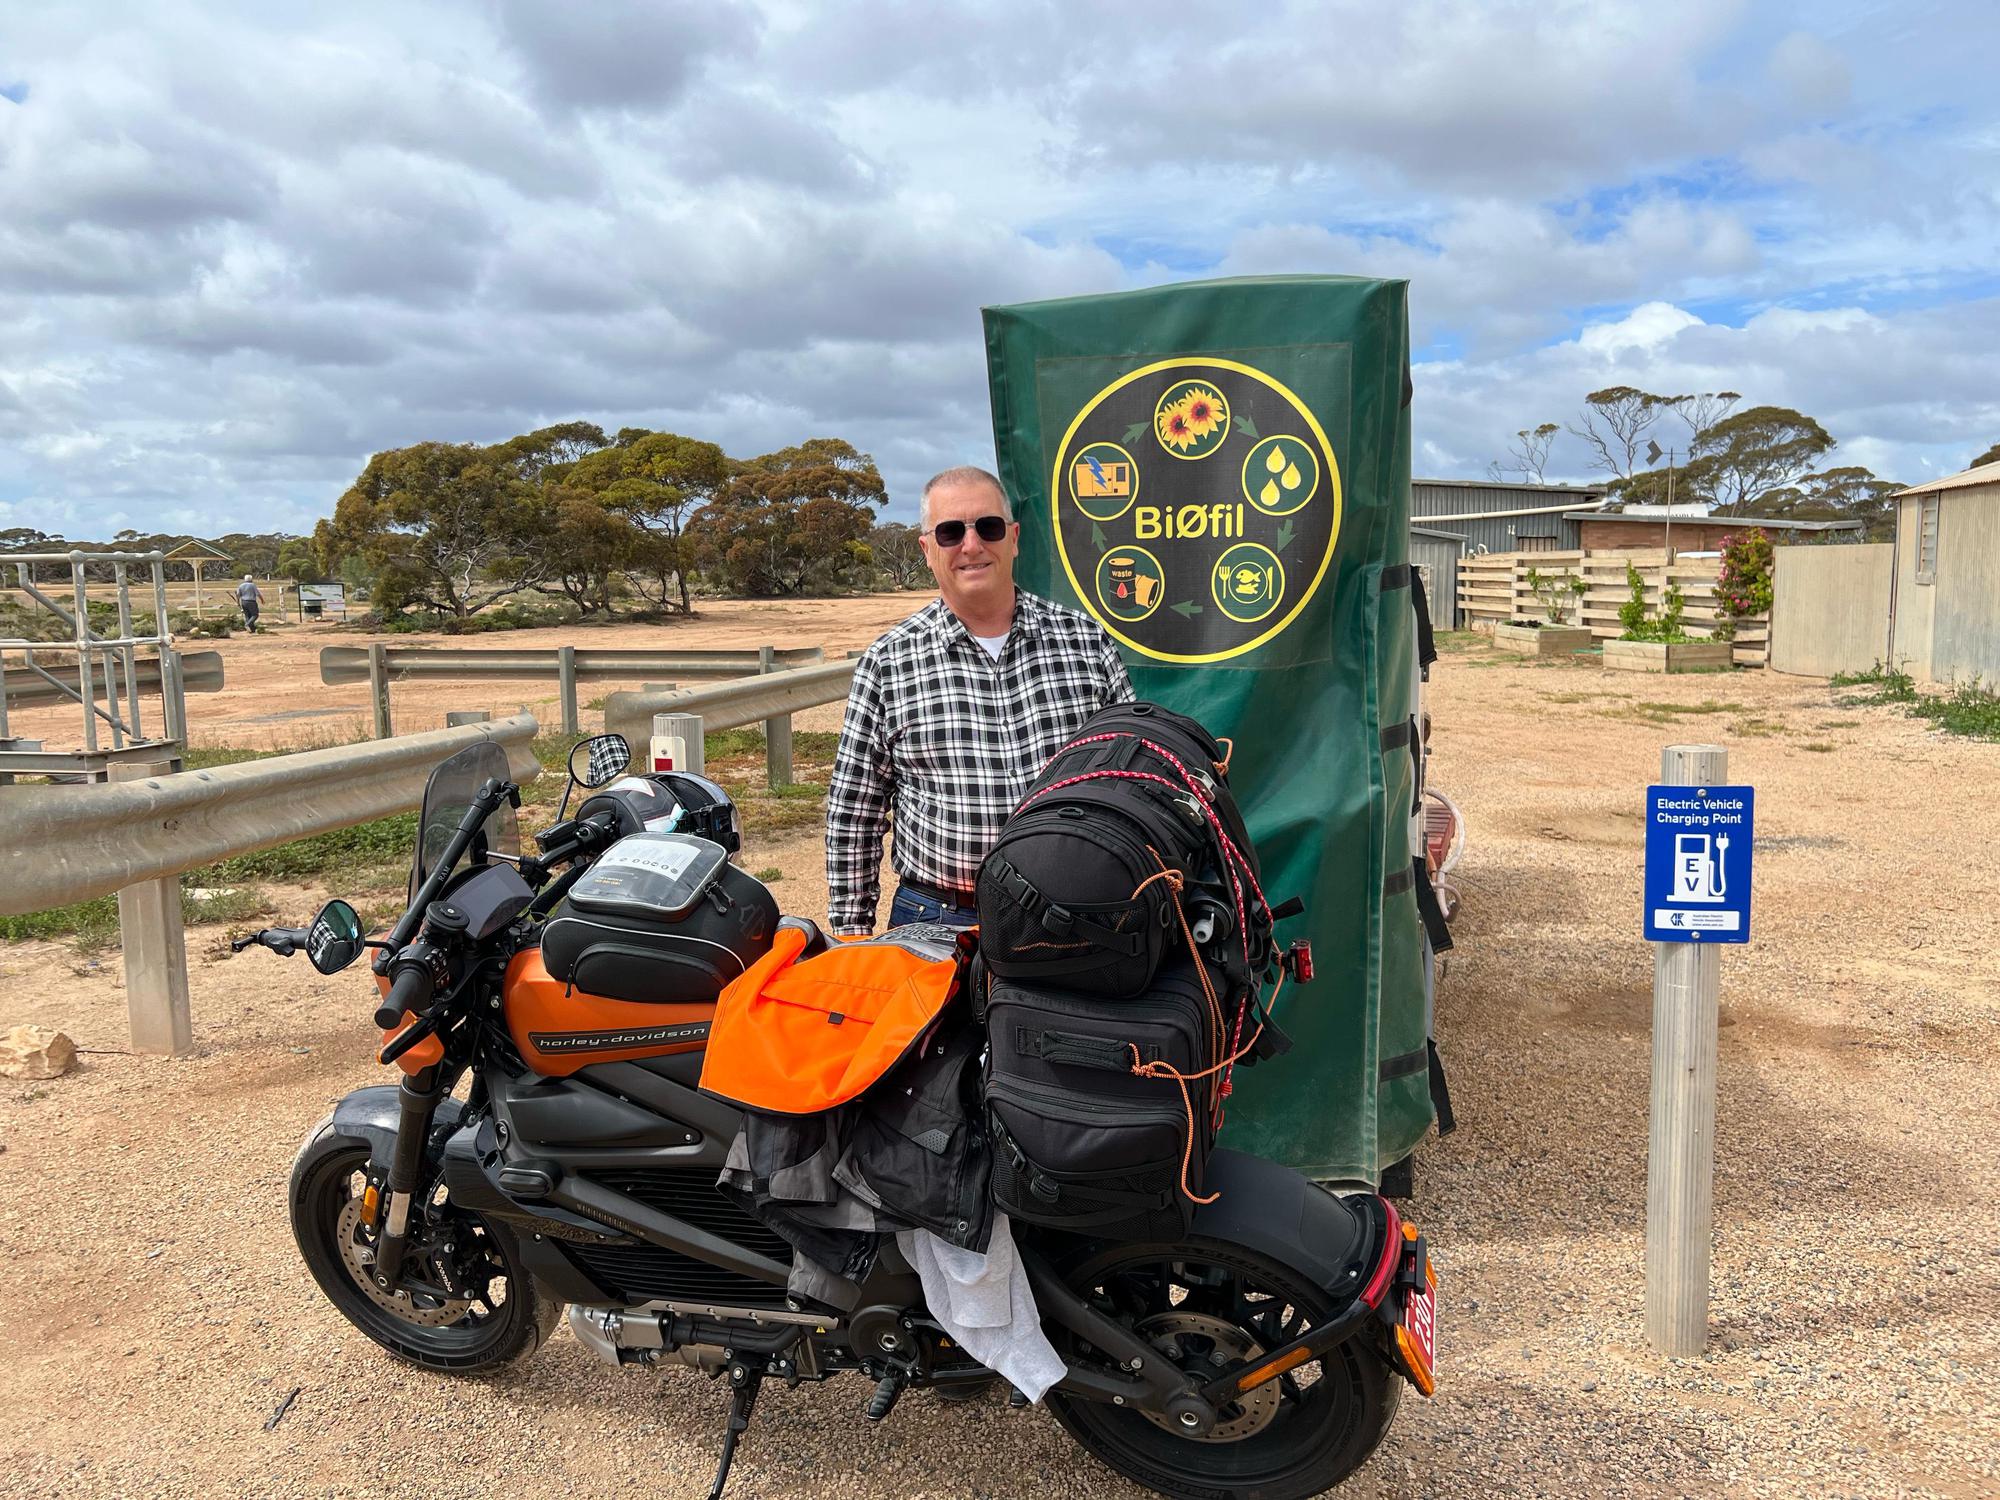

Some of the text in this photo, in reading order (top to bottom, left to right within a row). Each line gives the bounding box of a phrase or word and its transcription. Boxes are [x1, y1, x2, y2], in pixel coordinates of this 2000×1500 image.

[1111, 570, 1133, 578] waste
[1657, 798, 1744, 810] Electric Vehicle
[1656, 812, 1742, 826] Charging Point
[437, 865, 451, 882] RAM
[539, 1027, 706, 1047] harley-davidson
[435, 1260, 453, 1293] brembo
